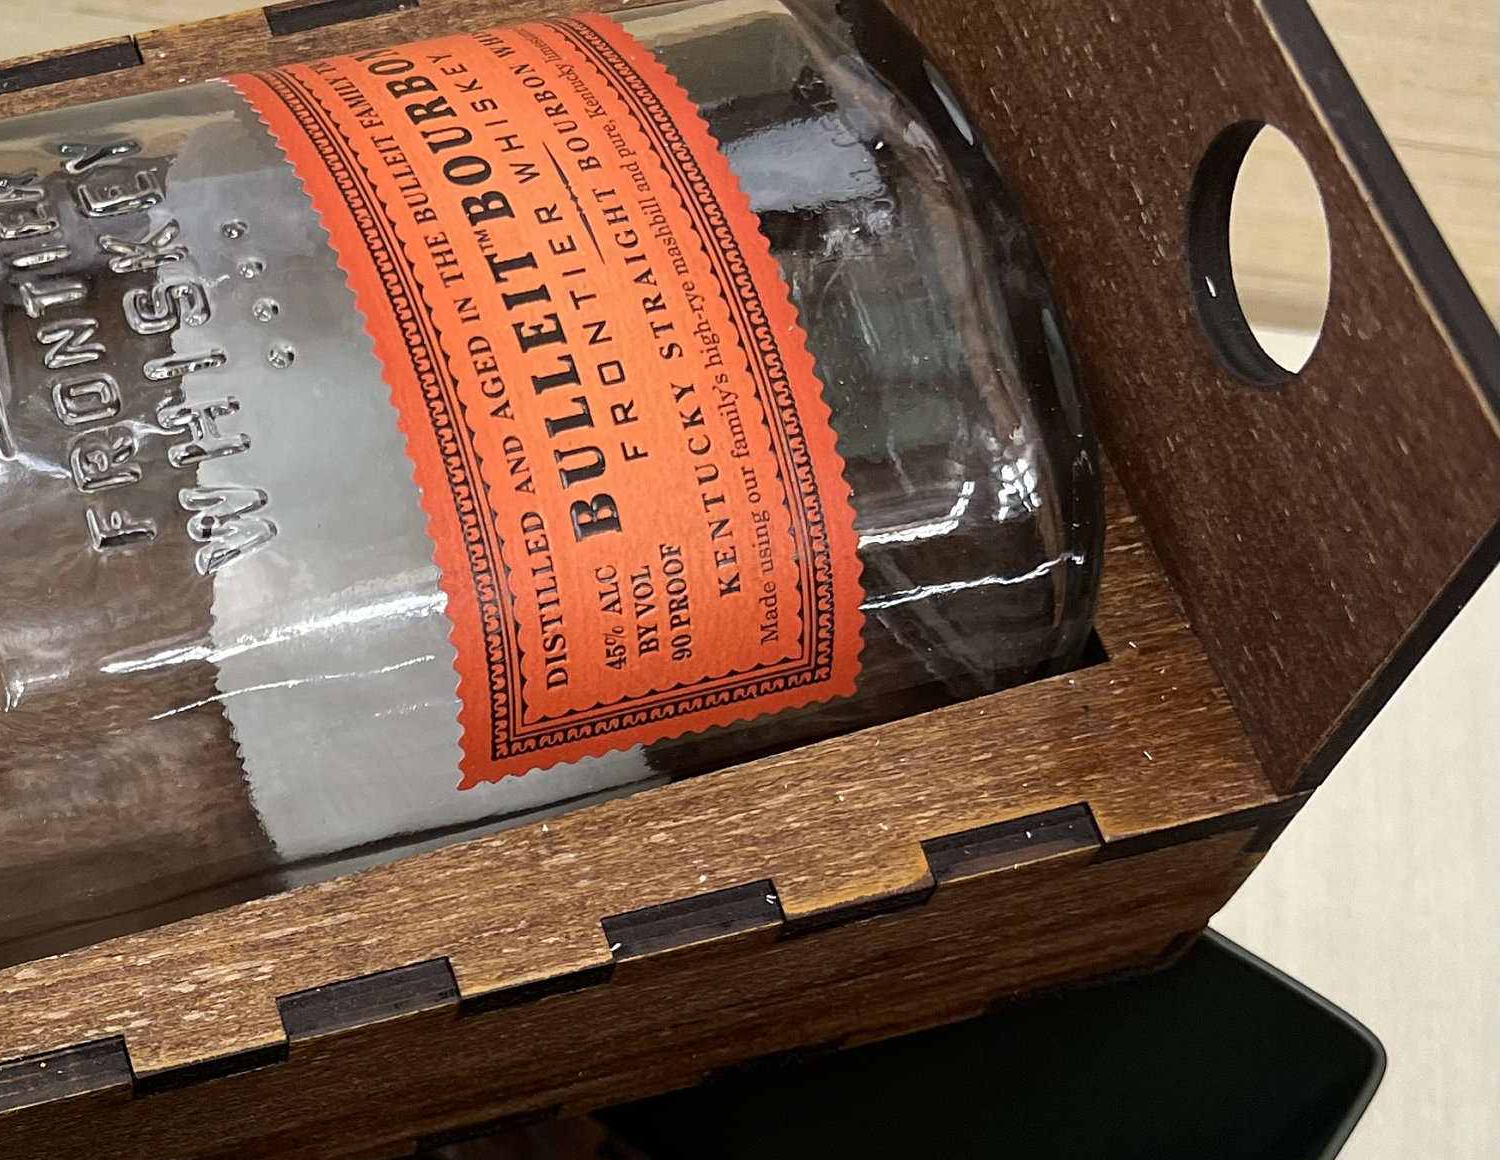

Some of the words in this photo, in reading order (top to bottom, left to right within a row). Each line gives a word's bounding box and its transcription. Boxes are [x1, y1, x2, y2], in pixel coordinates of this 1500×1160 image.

[325, 75, 385, 129] FAMILY
[427, 53, 541, 184] WHISKEY
[510, 63, 603, 173] BOURBON
[555, 63, 608, 119] Kentucky
[603, 116, 637, 165] pure,
[371, 136, 438, 224] BULLEIT
[628, 162, 651, 192] and
[425, 233, 465, 288] THE
[639, 197, 691, 278] mashbill
[592, 188, 685, 360] STRAIGHT
[454, 297, 482, 324] IN
[534, 203, 649, 462] FRONTIER
[682, 280, 724, 370] high-rye
[59, 140, 278, 576] WHISKEY
[468, 336, 514, 421] AGED
[503, 435, 536, 495] AND
[671, 384, 742, 598] KENTUCKY
[742, 466, 762, 503] our
[751, 510, 775, 574] using
[521, 511, 568, 690] DISTILLED
[595, 565, 623, 615] ALC
[630, 565, 656, 619] VOL
[659, 543, 691, 631] PROOF
[760, 581, 779, 646] Made
[604, 625, 627, 670] 45%
[637, 623, 660, 657] BY
[671, 634, 693, 661] 90
